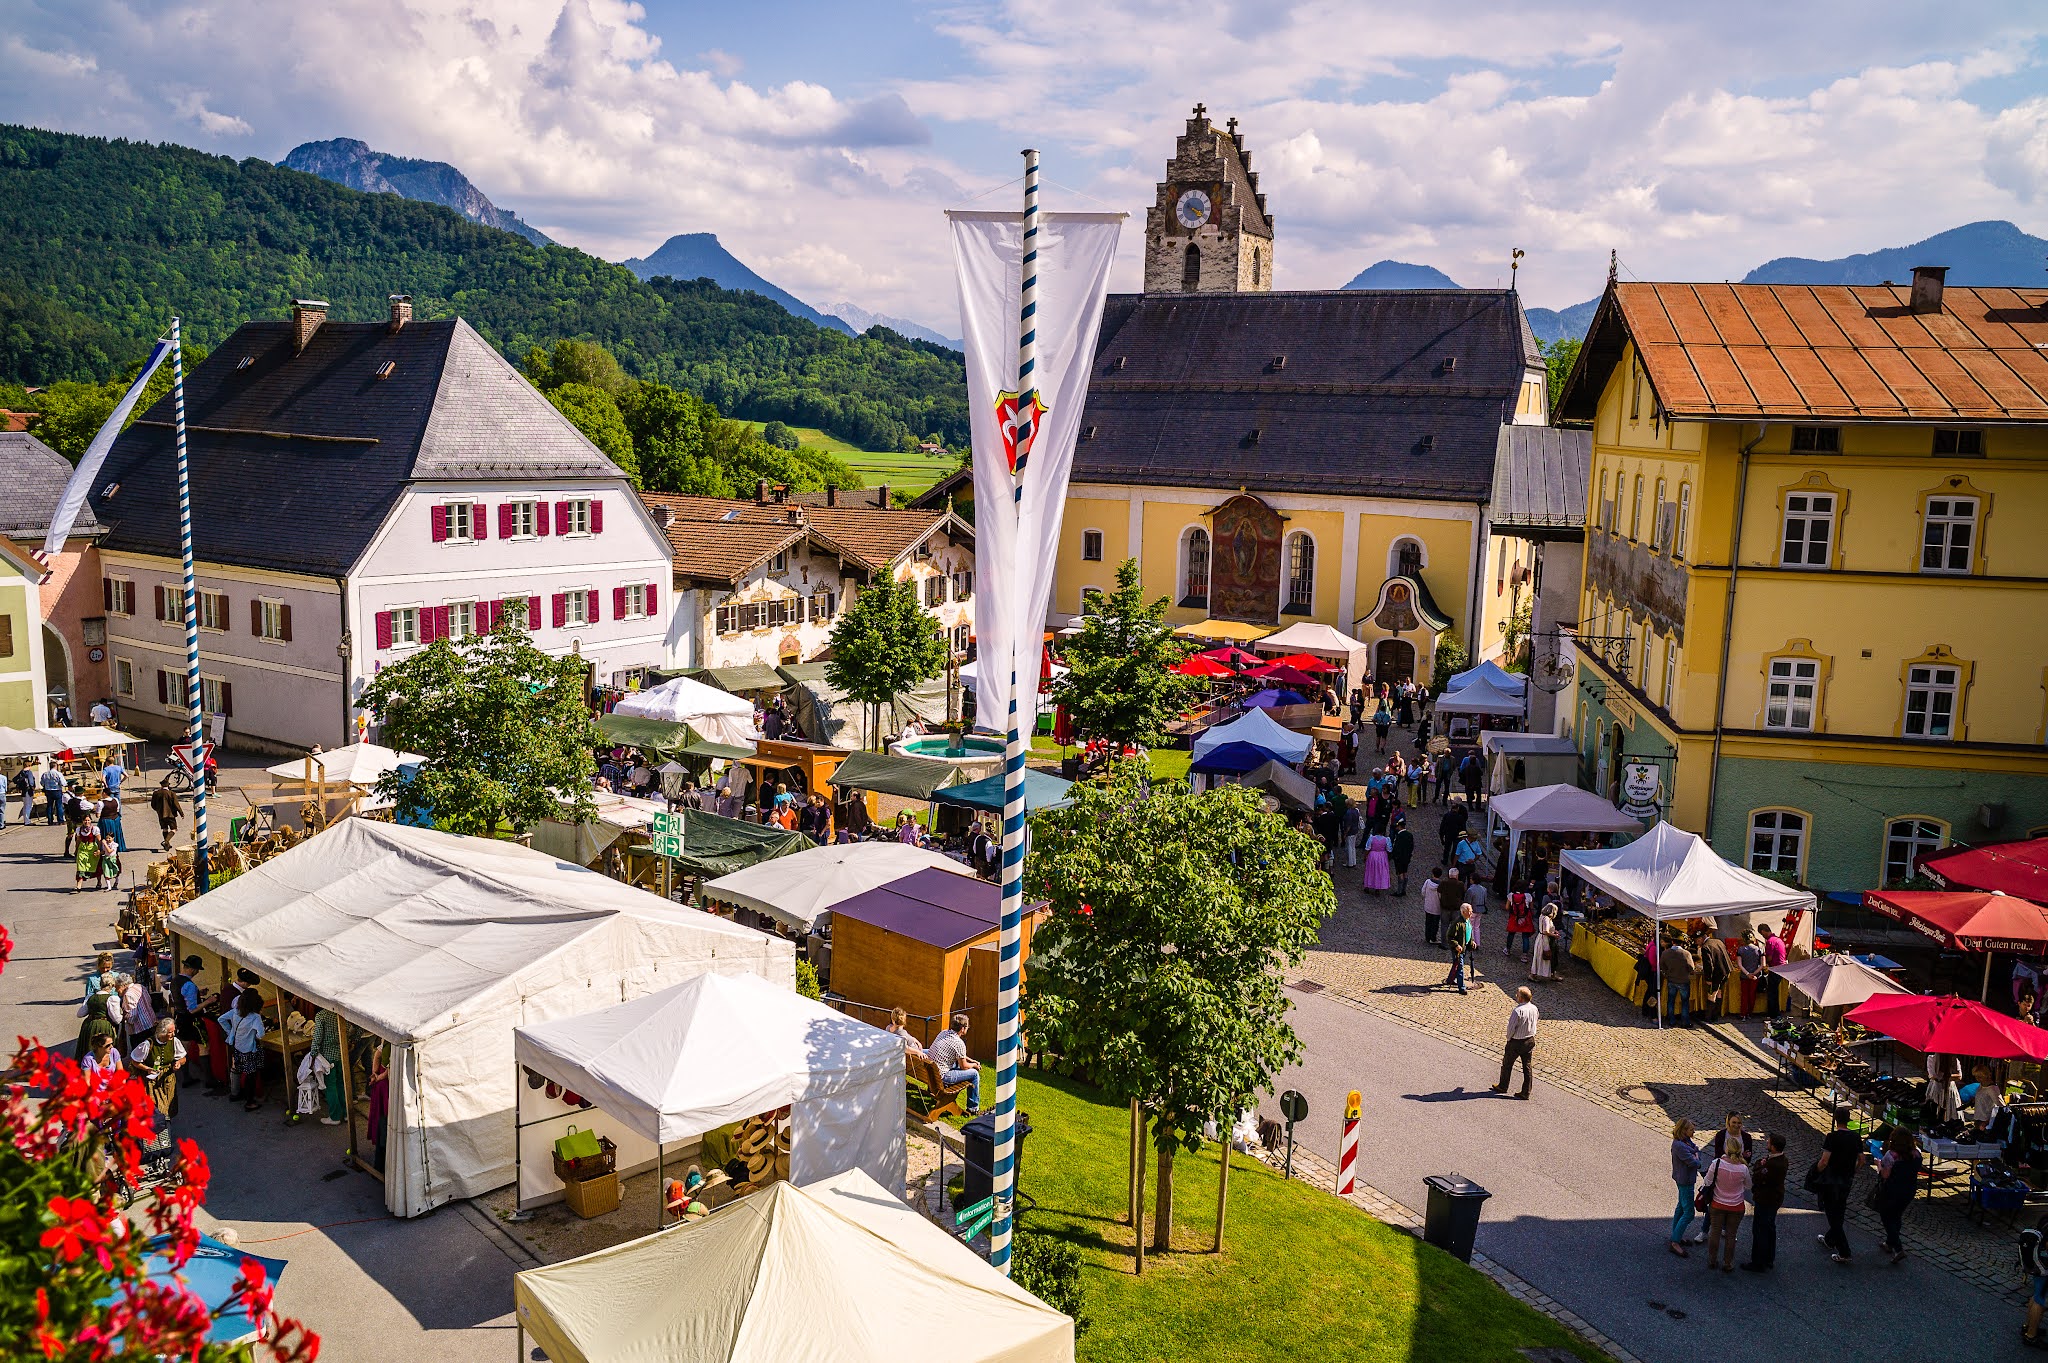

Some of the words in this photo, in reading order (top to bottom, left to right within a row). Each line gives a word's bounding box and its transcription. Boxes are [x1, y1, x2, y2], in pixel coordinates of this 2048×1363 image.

[1964, 937, 1983, 948] Dem
[1984, 938, 2009, 949] Guten
[2010, 941, 2034, 951] treu...
[963, 1202, 990, 1219] Information
